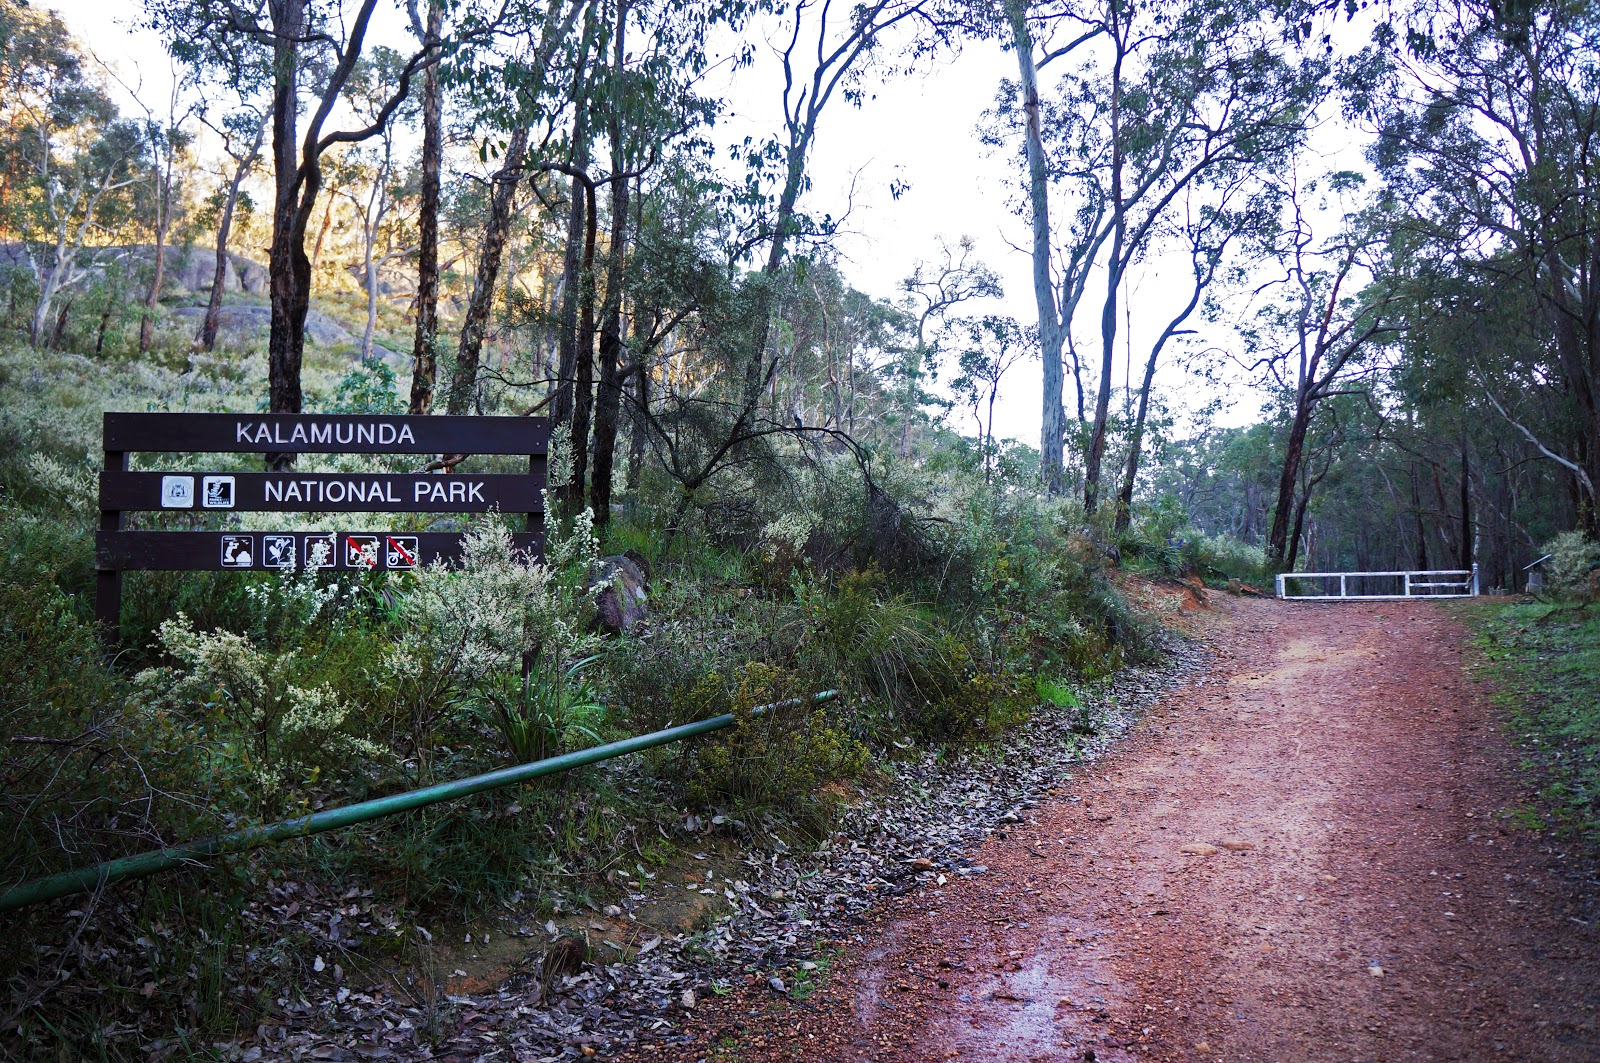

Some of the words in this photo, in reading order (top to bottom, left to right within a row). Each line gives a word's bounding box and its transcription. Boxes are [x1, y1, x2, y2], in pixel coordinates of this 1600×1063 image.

[235, 422, 416, 445] KALAMUNDA
[264, 480, 402, 503] NATIONAL
[414, 480, 485, 503] PARK
